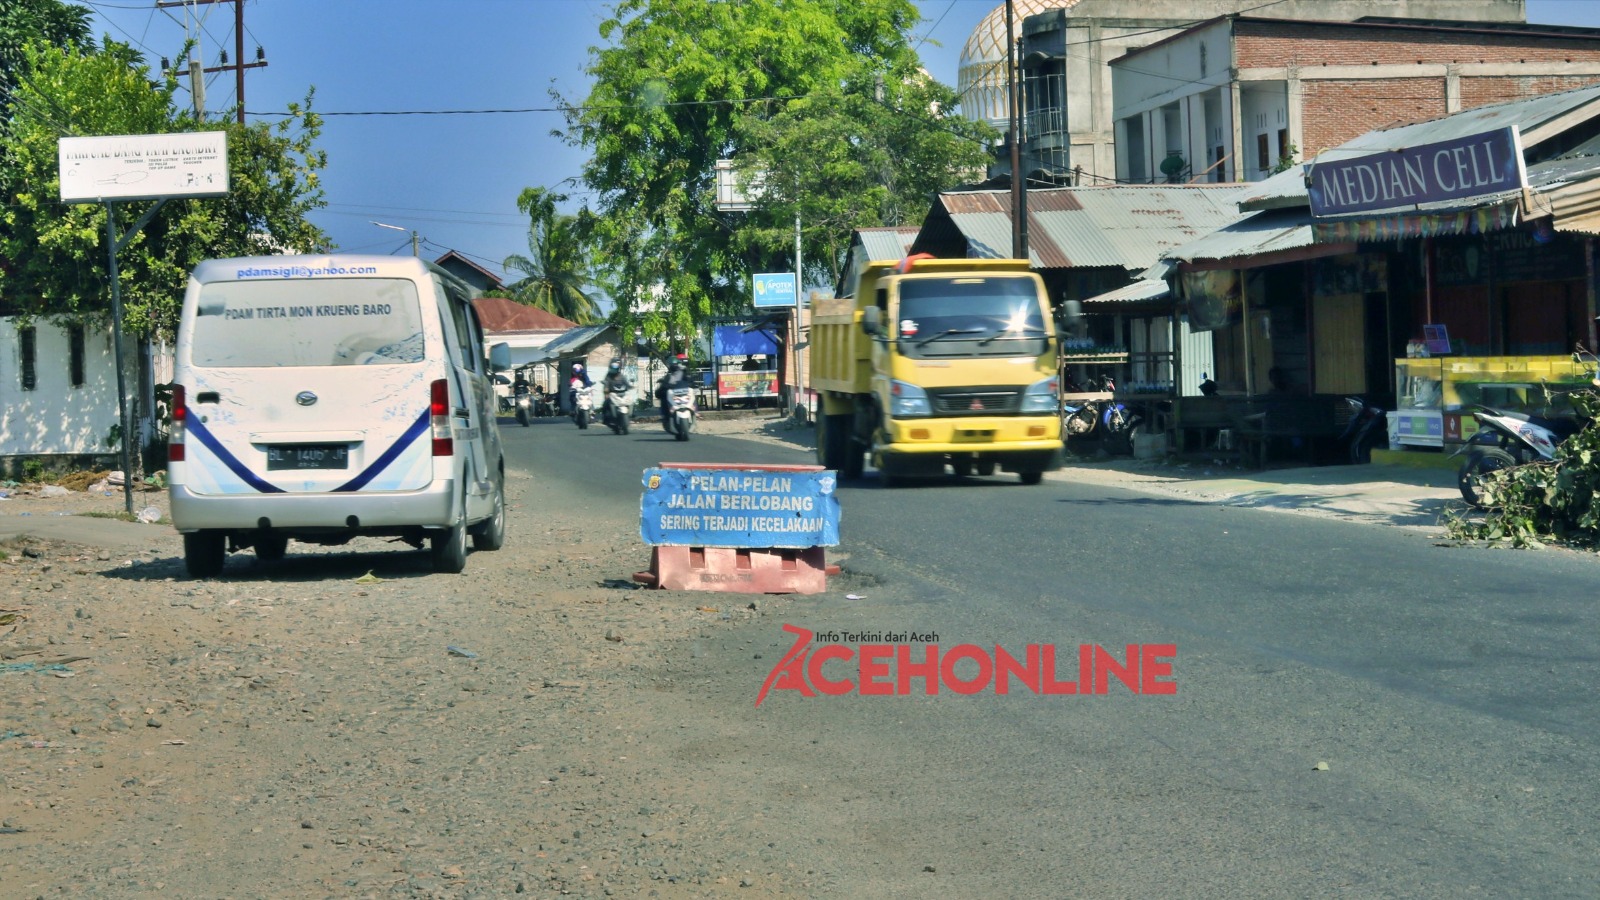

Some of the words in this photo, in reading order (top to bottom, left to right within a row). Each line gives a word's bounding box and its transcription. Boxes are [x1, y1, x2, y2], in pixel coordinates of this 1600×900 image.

[1321, 155, 1427, 208] MEDIAN
[1433, 141, 1504, 192] CELL
[237, 266, 377, 279] pdamsigli@yahoo.com
[225, 308, 254, 320] PDAM
[256, 306, 287, 319] TIRTA
[290, 306, 313, 318] MON
[316, 304, 360, 317] KRUENG
[363, 303, 392, 316] BARO
[690, 475, 791, 493] PELAN-PELAN
[667, 493, 716, 509] JALAN
[720, 495, 814, 511] BERLOBANG
[660, 515, 700, 530] SERING
[703, 516, 748, 531] TERJADI
[751, 516, 823, 532] KECELAKAAN
